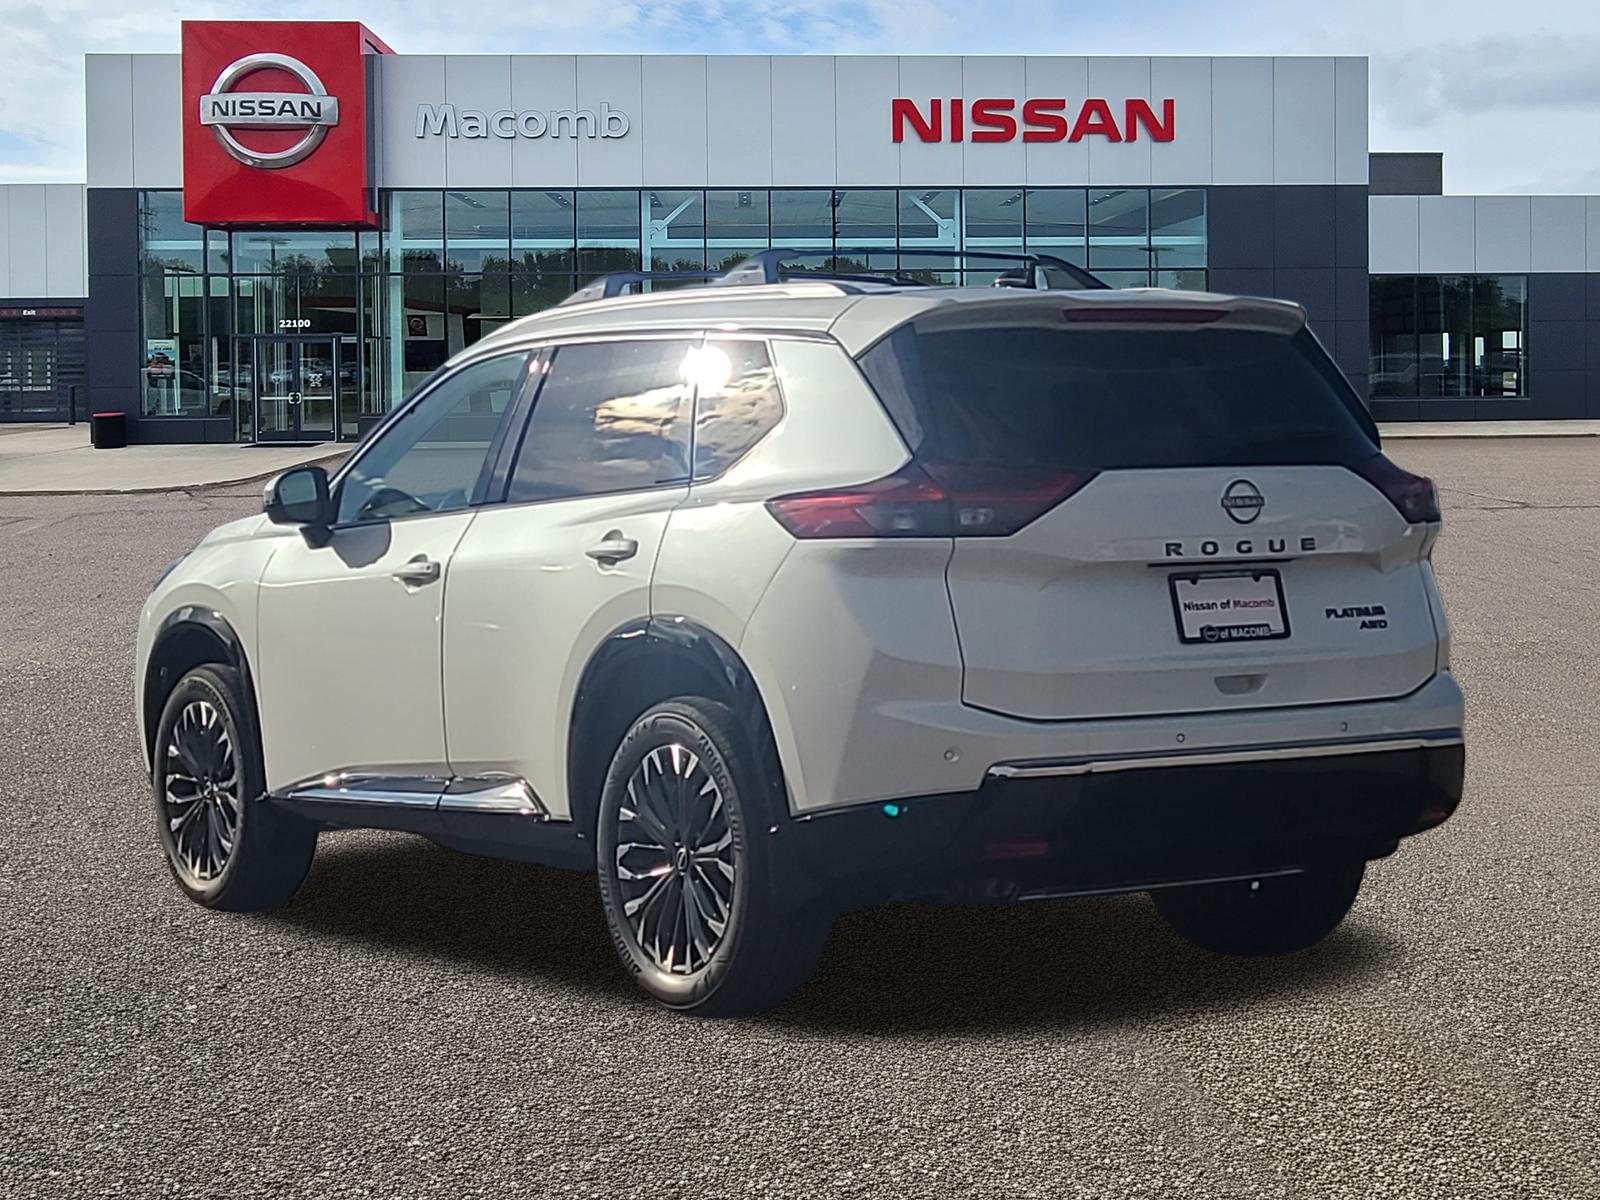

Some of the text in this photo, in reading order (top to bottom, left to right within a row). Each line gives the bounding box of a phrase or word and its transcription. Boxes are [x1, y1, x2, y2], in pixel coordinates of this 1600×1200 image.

[212, 100, 321, 117] NISSAN
[415, 102, 629, 139] Macomb
[892, 98, 1175, 142] NISSAN
[279, 319, 311, 328] 22100
[1165, 537, 1316, 557] ROGUE
[1184, 599, 1275, 611] Nissan of Macomb
[1325, 606, 1386, 619] PLATINUM
[1220, 630, 1229, 638] of
[1230, 627, 1270, 637] MACOMB
